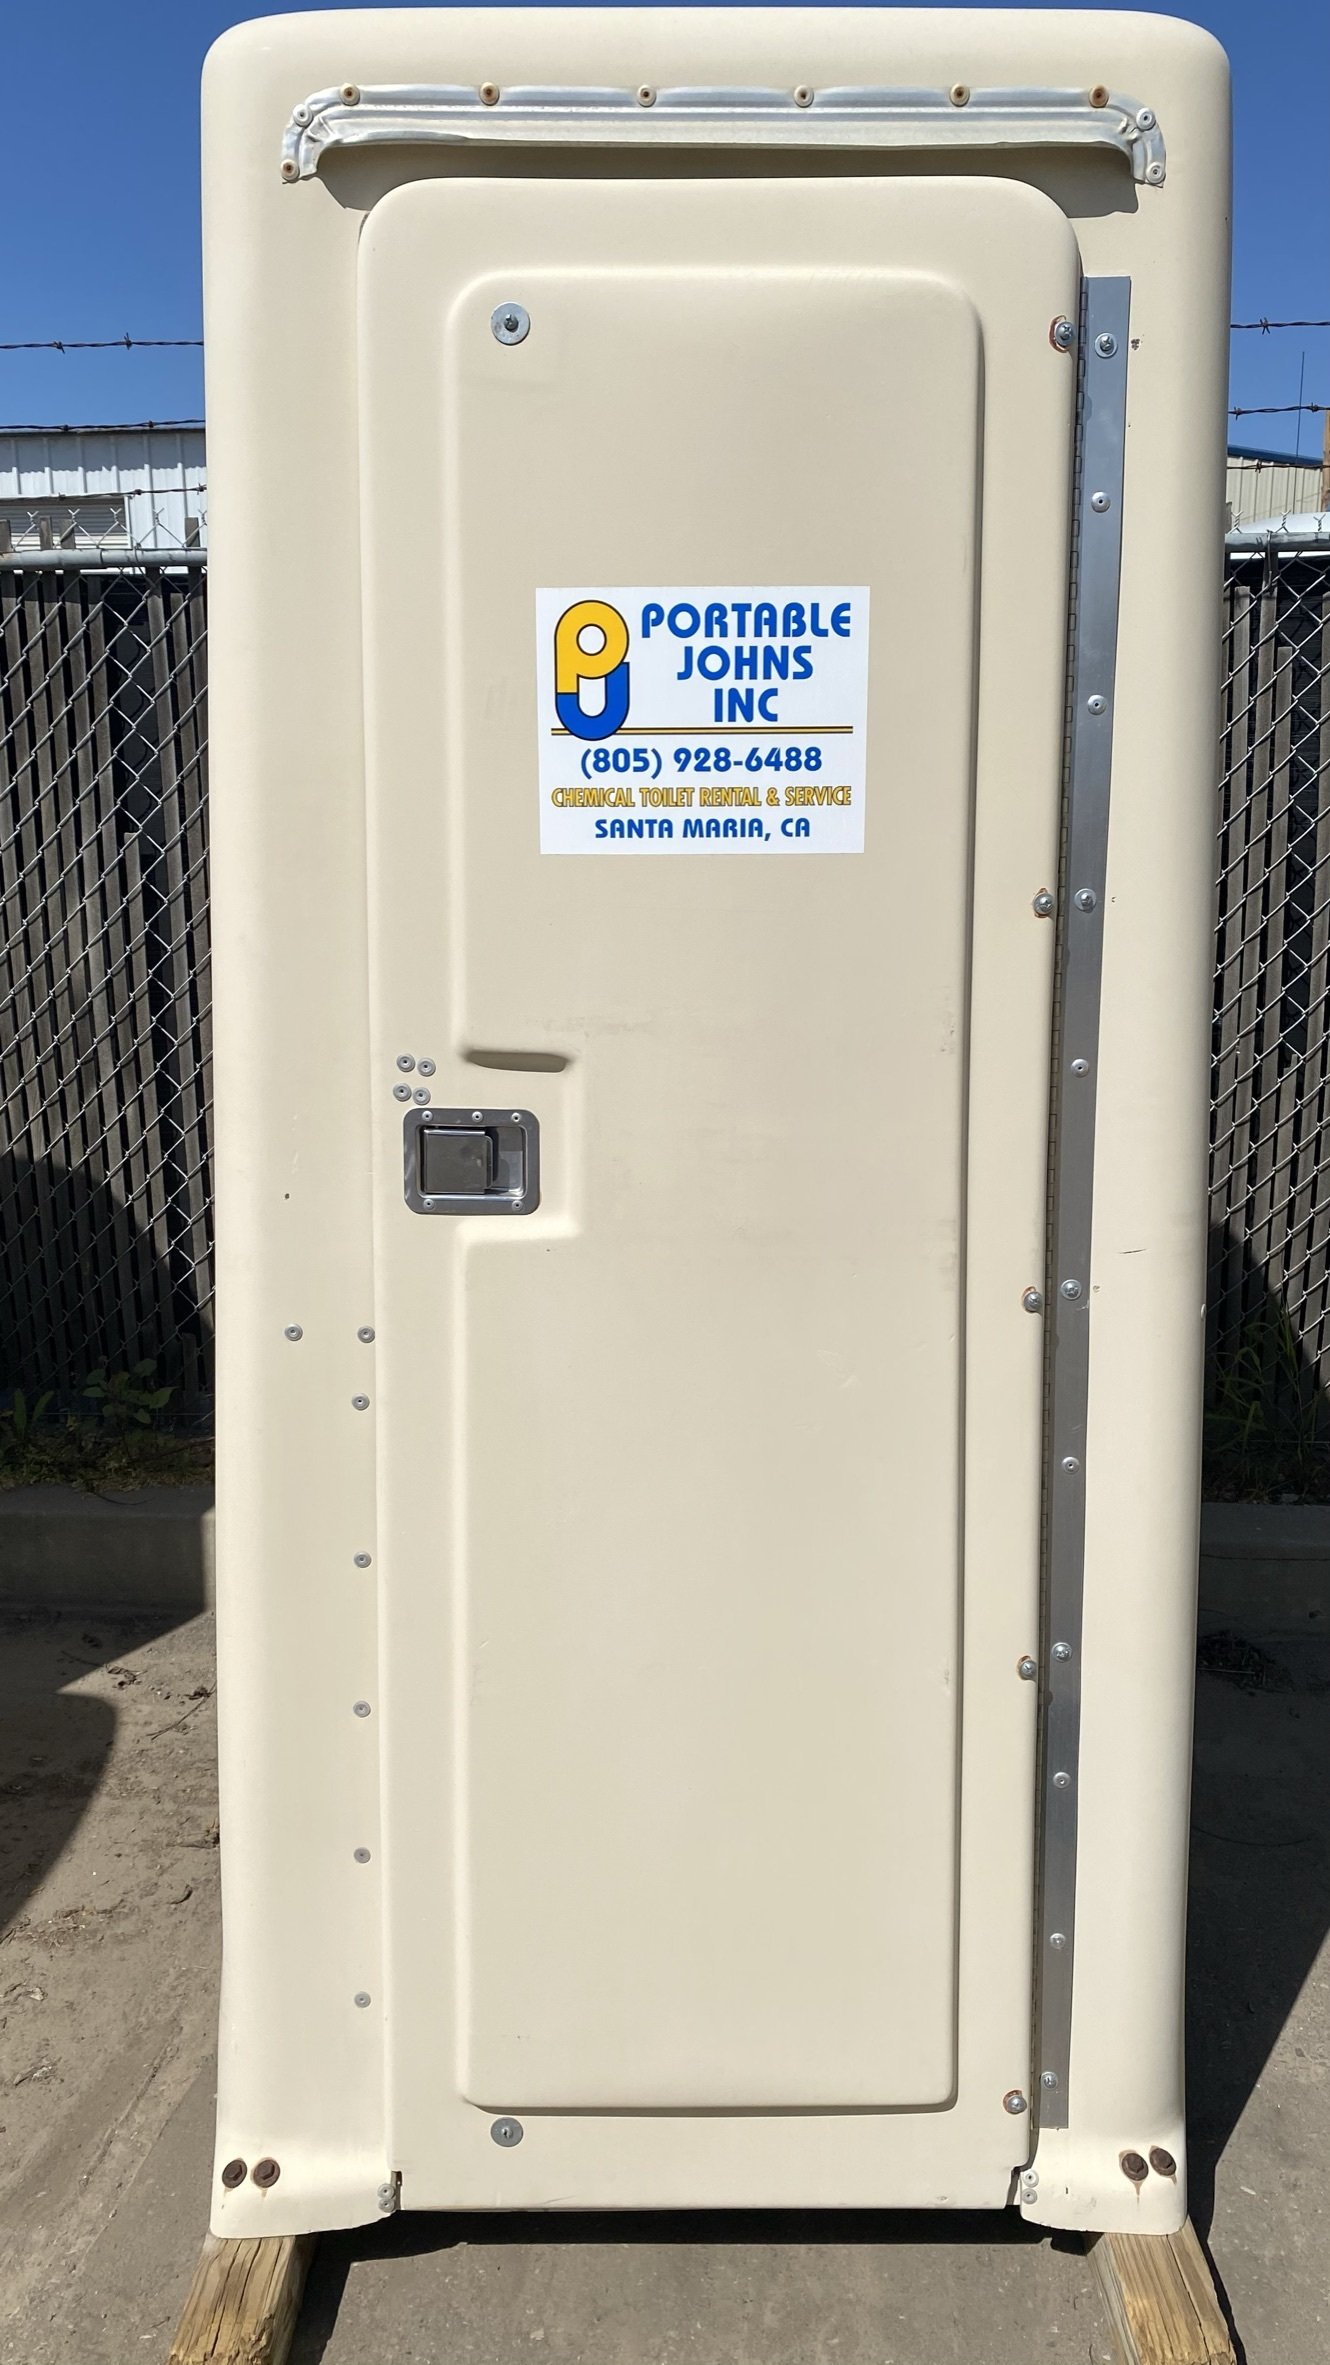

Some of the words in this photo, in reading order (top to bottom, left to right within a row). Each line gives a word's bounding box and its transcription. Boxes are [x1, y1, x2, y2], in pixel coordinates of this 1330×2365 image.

[641, 602, 851, 639] PORTABLE
[677, 645, 813, 680] JOHNS
[714, 688, 778, 722] INC
[581, 748, 662, 779] (805)
[674, 747, 822, 772] 928-6488
[551, 787, 634, 808] CHEMICAL
[640, 787, 695, 807] TOILET
[700, 787, 761, 807] RENTAL
[766, 787, 780, 806] &
[785, 786, 851, 806] SERVICE
[595, 819, 673, 839] SANTA
[683, 819, 771, 841] MARIA,
[781, 818, 810, 837] CA
